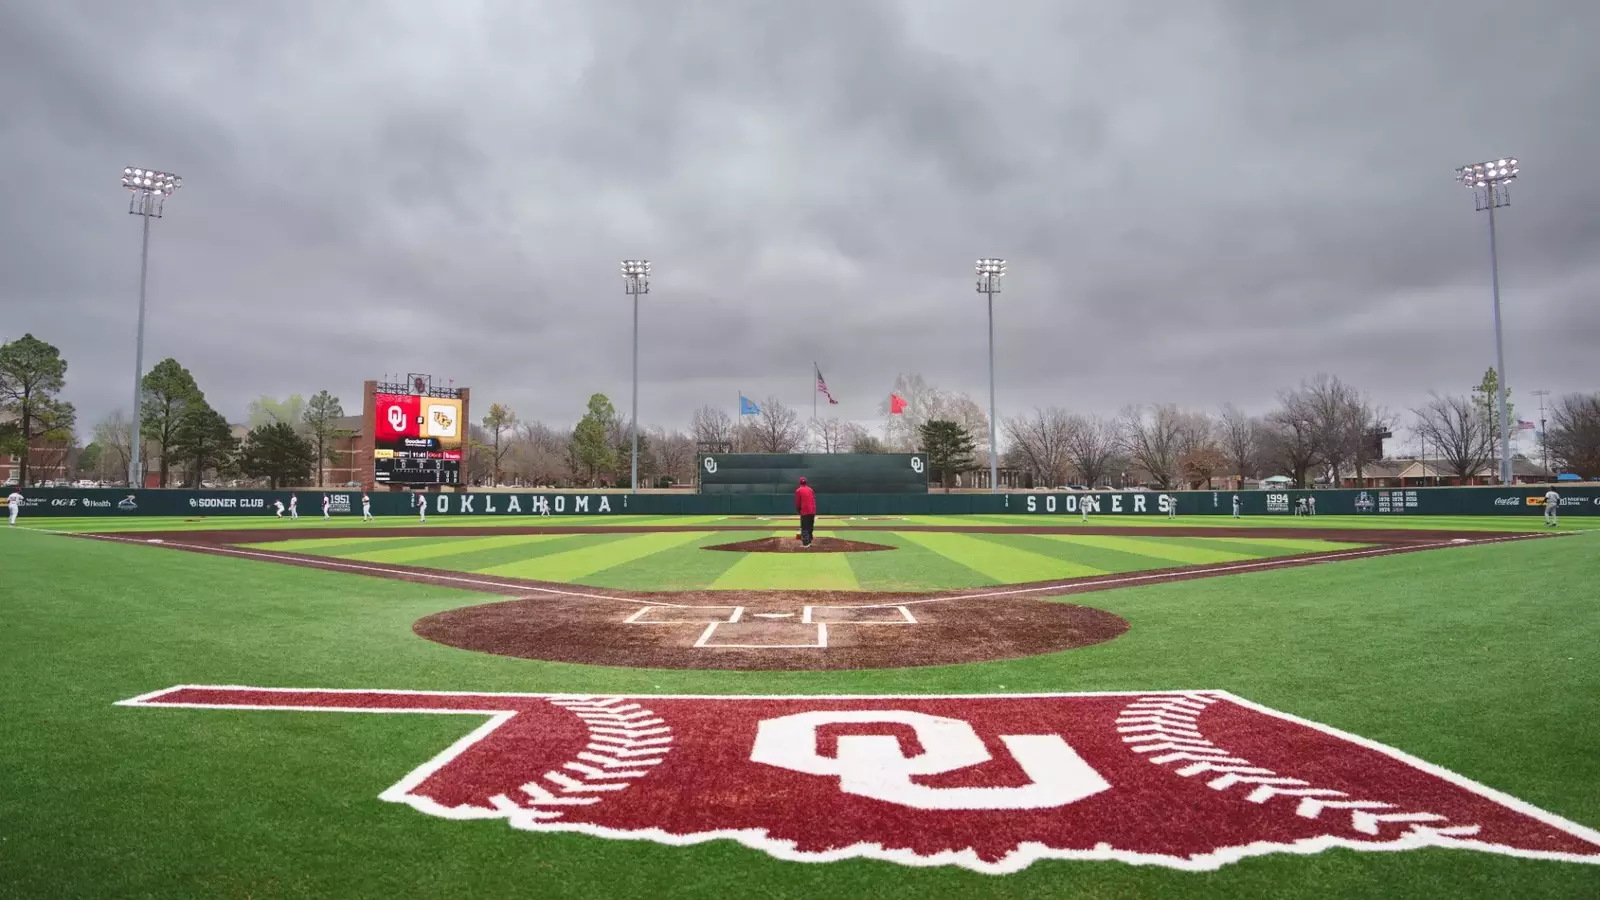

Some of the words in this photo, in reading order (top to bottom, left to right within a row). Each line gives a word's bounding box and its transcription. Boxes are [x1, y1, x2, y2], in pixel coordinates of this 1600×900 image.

[388, 405, 407, 432] OU
[704, 457, 718, 473] OU
[911, 456, 924, 473] OU
[91, 499, 111, 507] Health
[198, 498, 237, 507] SOONER
[240, 498, 264, 507] CLUB
[330, 494, 350, 504] 1951
[437, 495, 611, 513] OKLAHOMA
[1027, 494, 1170, 512] SOONERS
[1266, 494, 1289, 503] 1994
[749, 709, 1113, 810] OU
